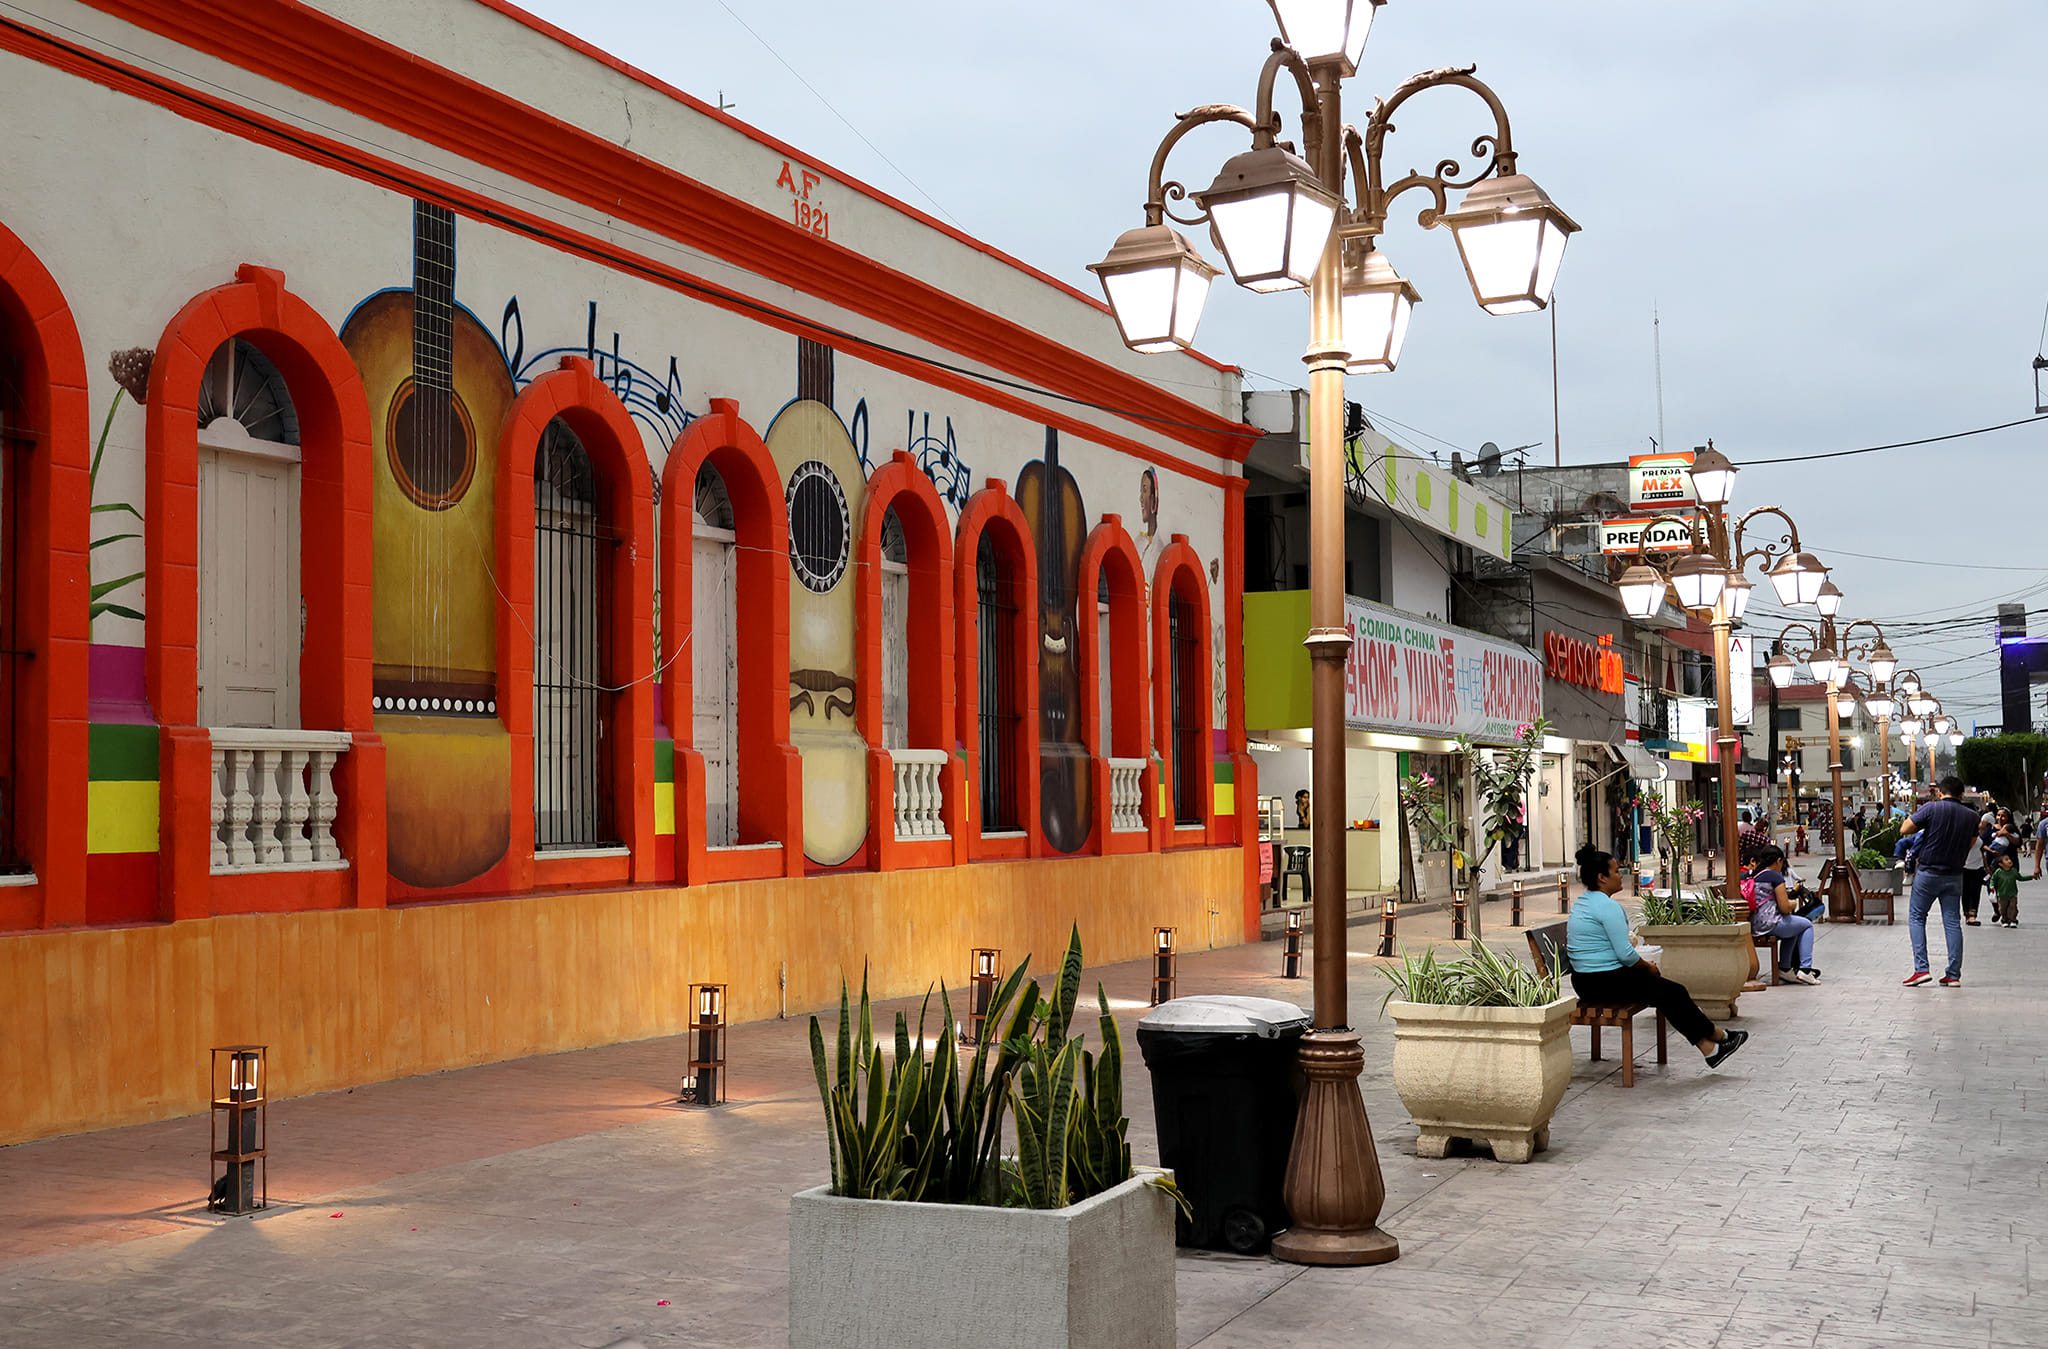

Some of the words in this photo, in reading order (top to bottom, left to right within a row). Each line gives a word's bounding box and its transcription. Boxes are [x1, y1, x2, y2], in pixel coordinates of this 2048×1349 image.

[794, 199, 829, 238] 1921
[1642, 468, 1681, 477] PRENDA
[1642, 477, 1683, 491] MEX
[1359, 616, 1402, 643] COMIDA
[1404, 627, 1435, 651] CHINA
[1358, 637, 1399, 720] HONG
[1404, 647, 1441, 725] YUAN
[1482, 648, 1542, 722] CHACHARAS
